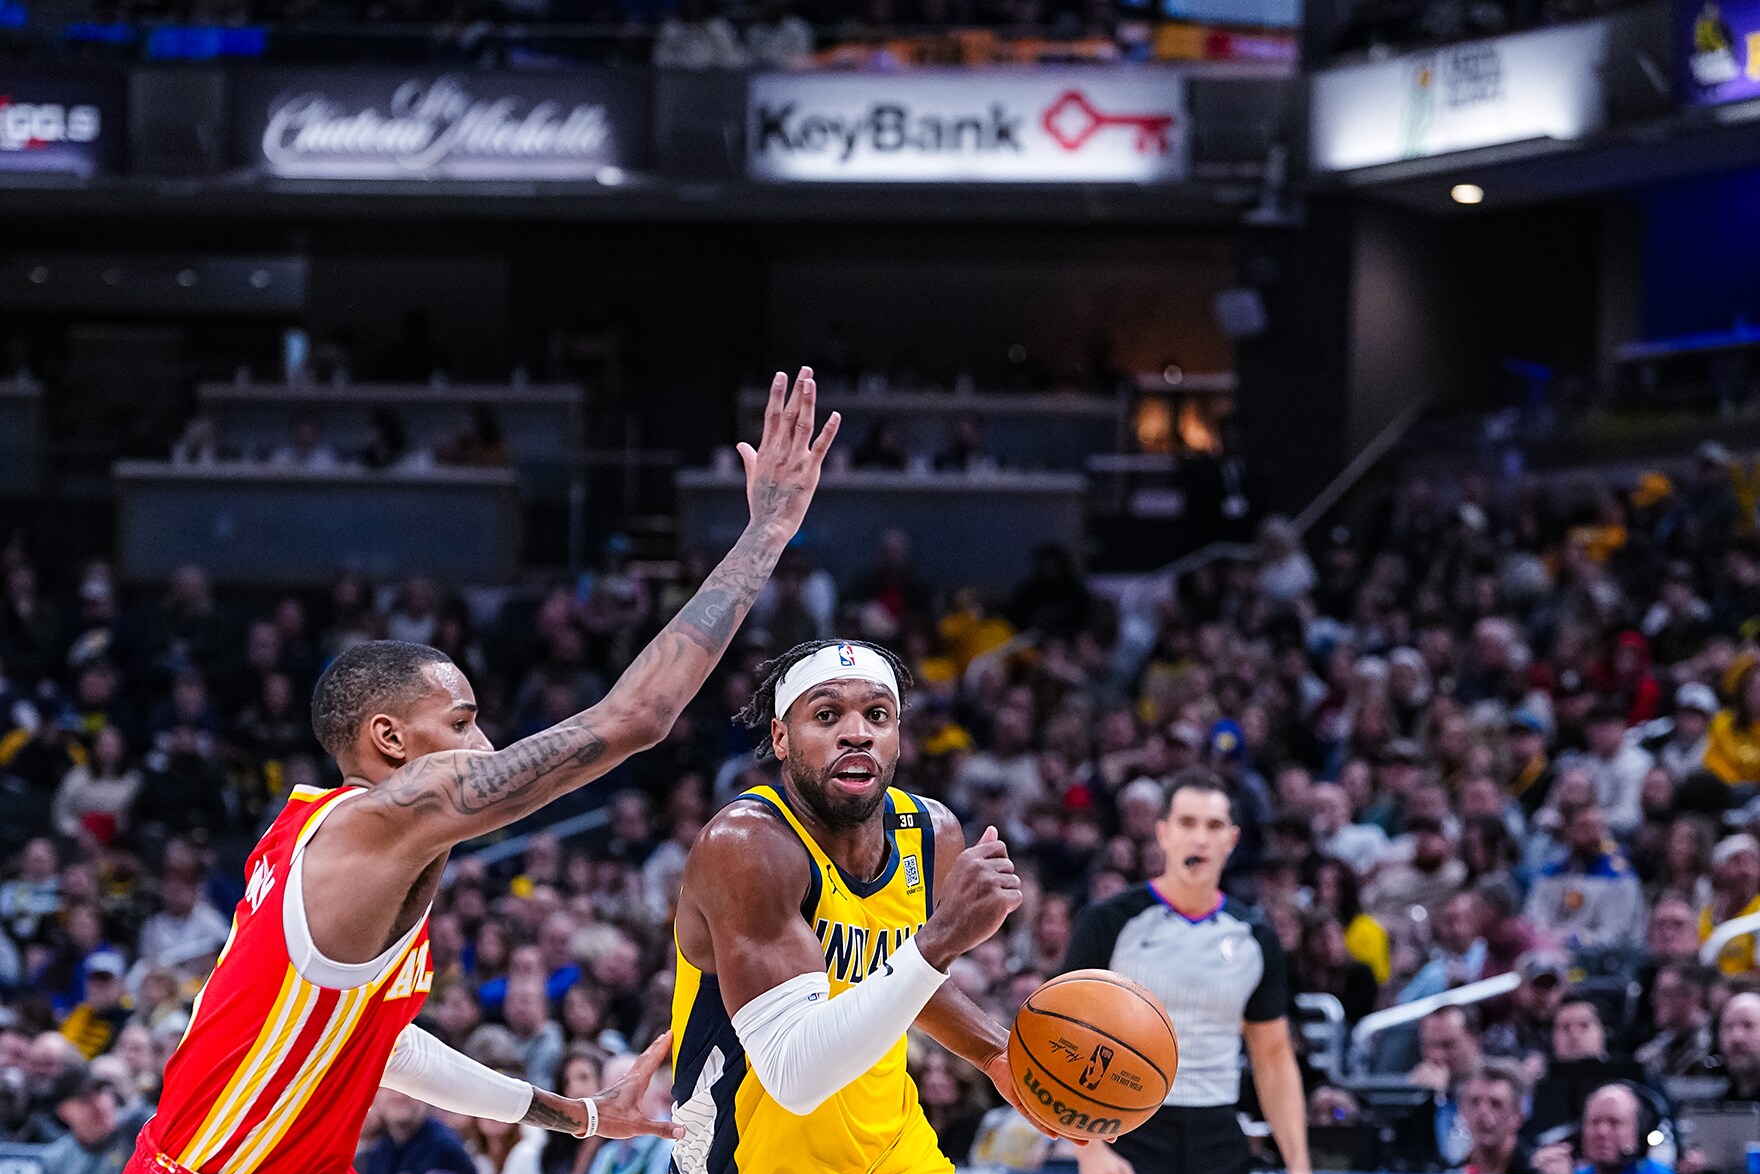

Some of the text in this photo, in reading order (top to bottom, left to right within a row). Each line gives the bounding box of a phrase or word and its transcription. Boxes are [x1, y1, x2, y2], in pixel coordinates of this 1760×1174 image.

[757, 103, 1024, 161] KeyBank
[899, 814, 915, 828] 30
[1022, 1066, 1122, 1136] Wilson
